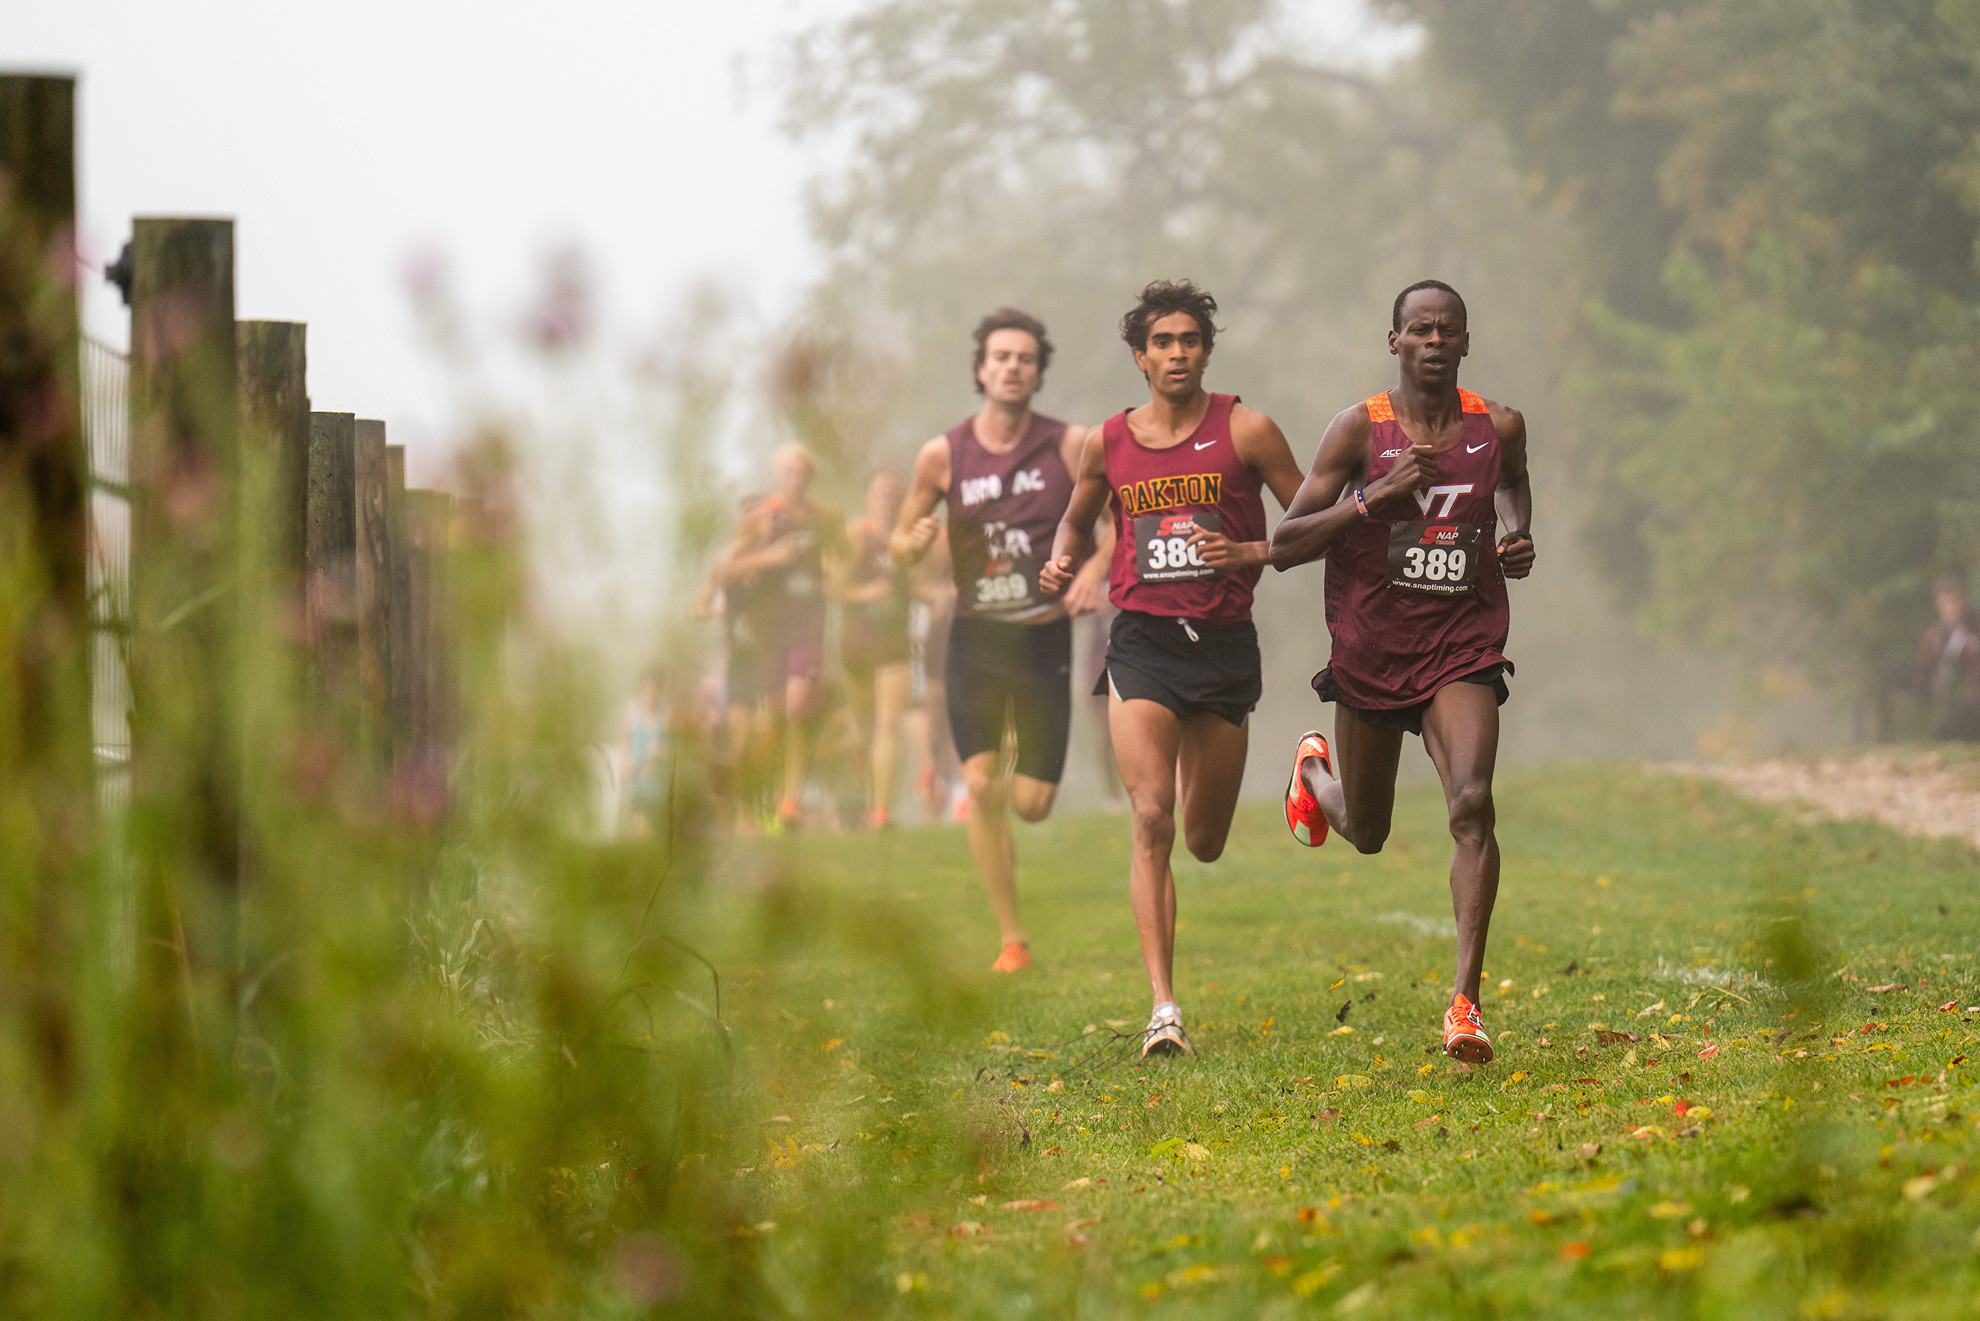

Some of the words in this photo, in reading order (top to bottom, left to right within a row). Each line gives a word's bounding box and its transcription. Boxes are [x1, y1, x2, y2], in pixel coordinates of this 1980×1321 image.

[1379, 448, 1403, 458] ACC
[1119, 473, 1222, 515] OAKTON
[1418, 525, 1459, 545] SNAP
[1402, 547, 1467, 582] 389
[1142, 568, 1216, 580] www.snaptiming.com
[1391, 578, 1468, 593] www.snaptiming.com
